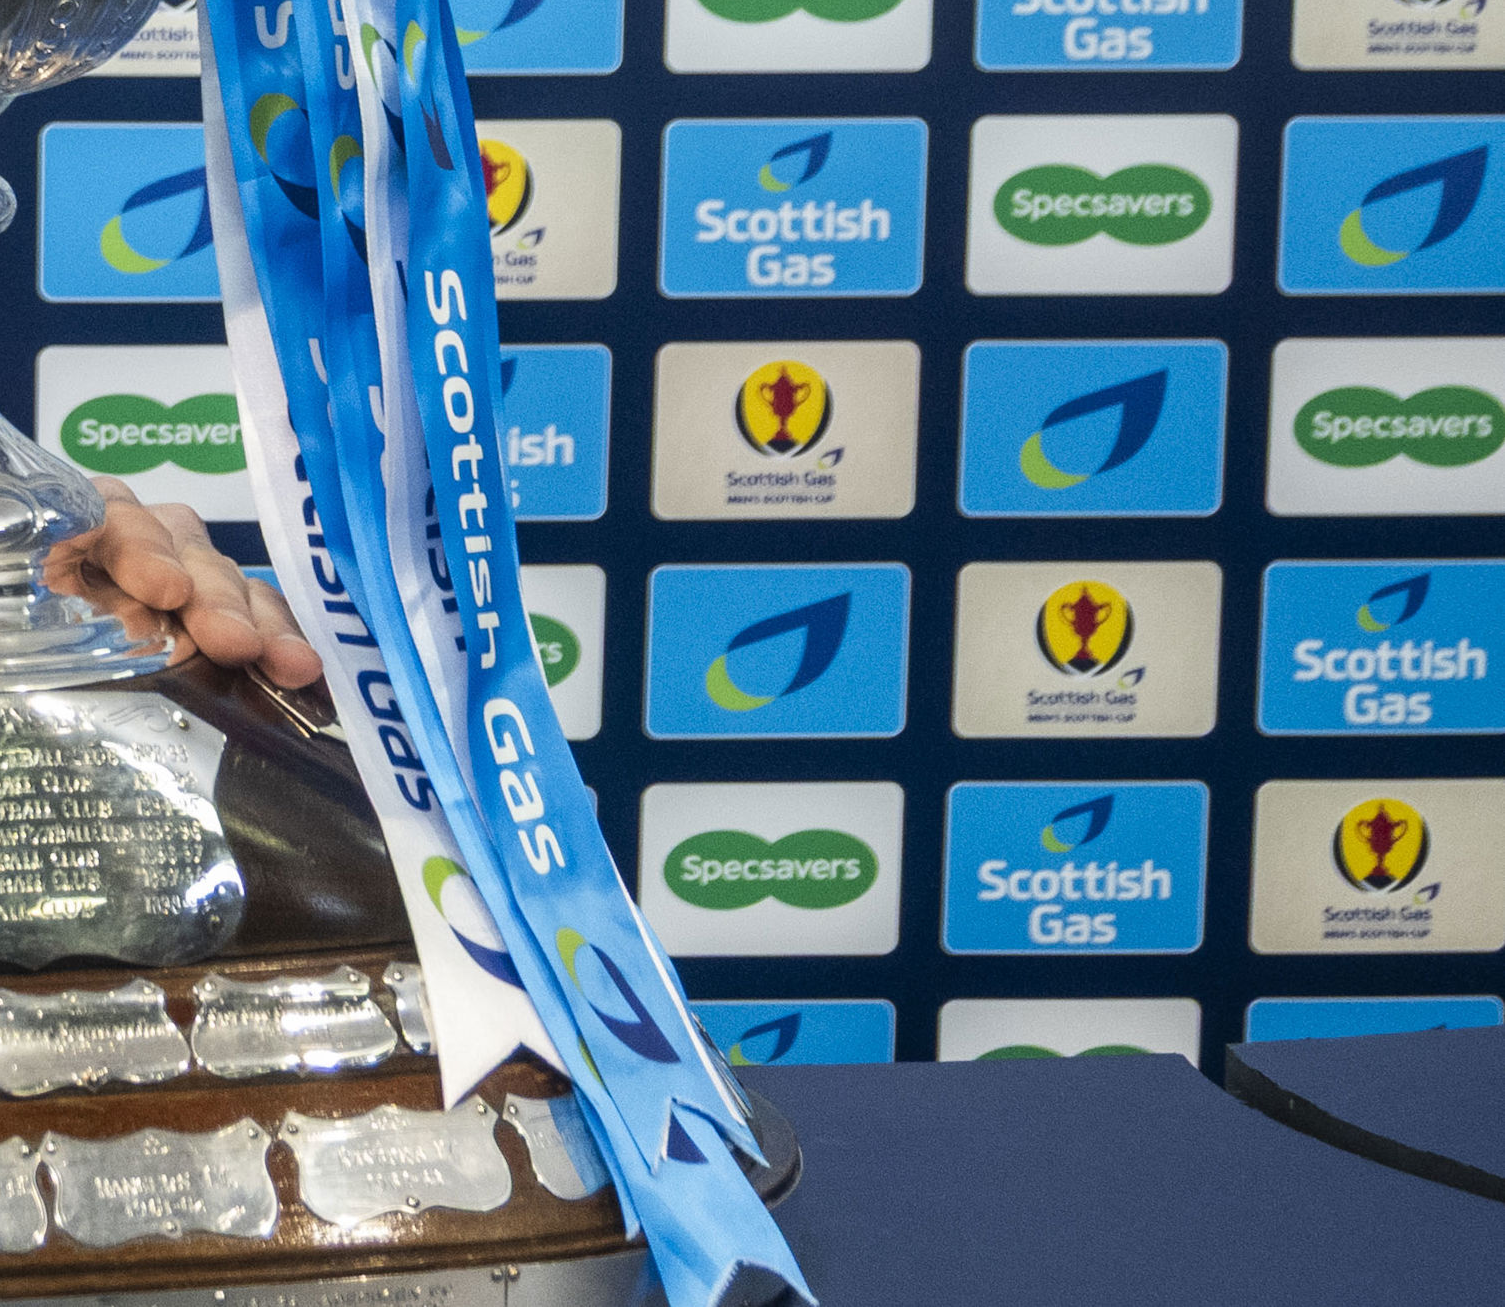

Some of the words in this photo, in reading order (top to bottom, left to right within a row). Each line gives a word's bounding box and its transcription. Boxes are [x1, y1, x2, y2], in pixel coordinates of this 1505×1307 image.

[1064, 17, 1153, 60] Gas
[695, 199, 890, 245] Scottish
[1012, 189, 1194, 221] Specsavers
[747, 244, 835, 286] Gas
[79, 421, 238, 449] Specsaver
[1312, 411, 1493, 443] Specsavers
[424, 268, 500, 670] Scottish
[483, 697, 566, 876] Gas
[1294, 638, 1487, 681] Scottish
[1344, 683, 1432, 725] Gas
[681, 854, 861, 885] Specsavers
[978, 860, 1171, 901] Scottish
[1029, 904, 1116, 944] Gas
